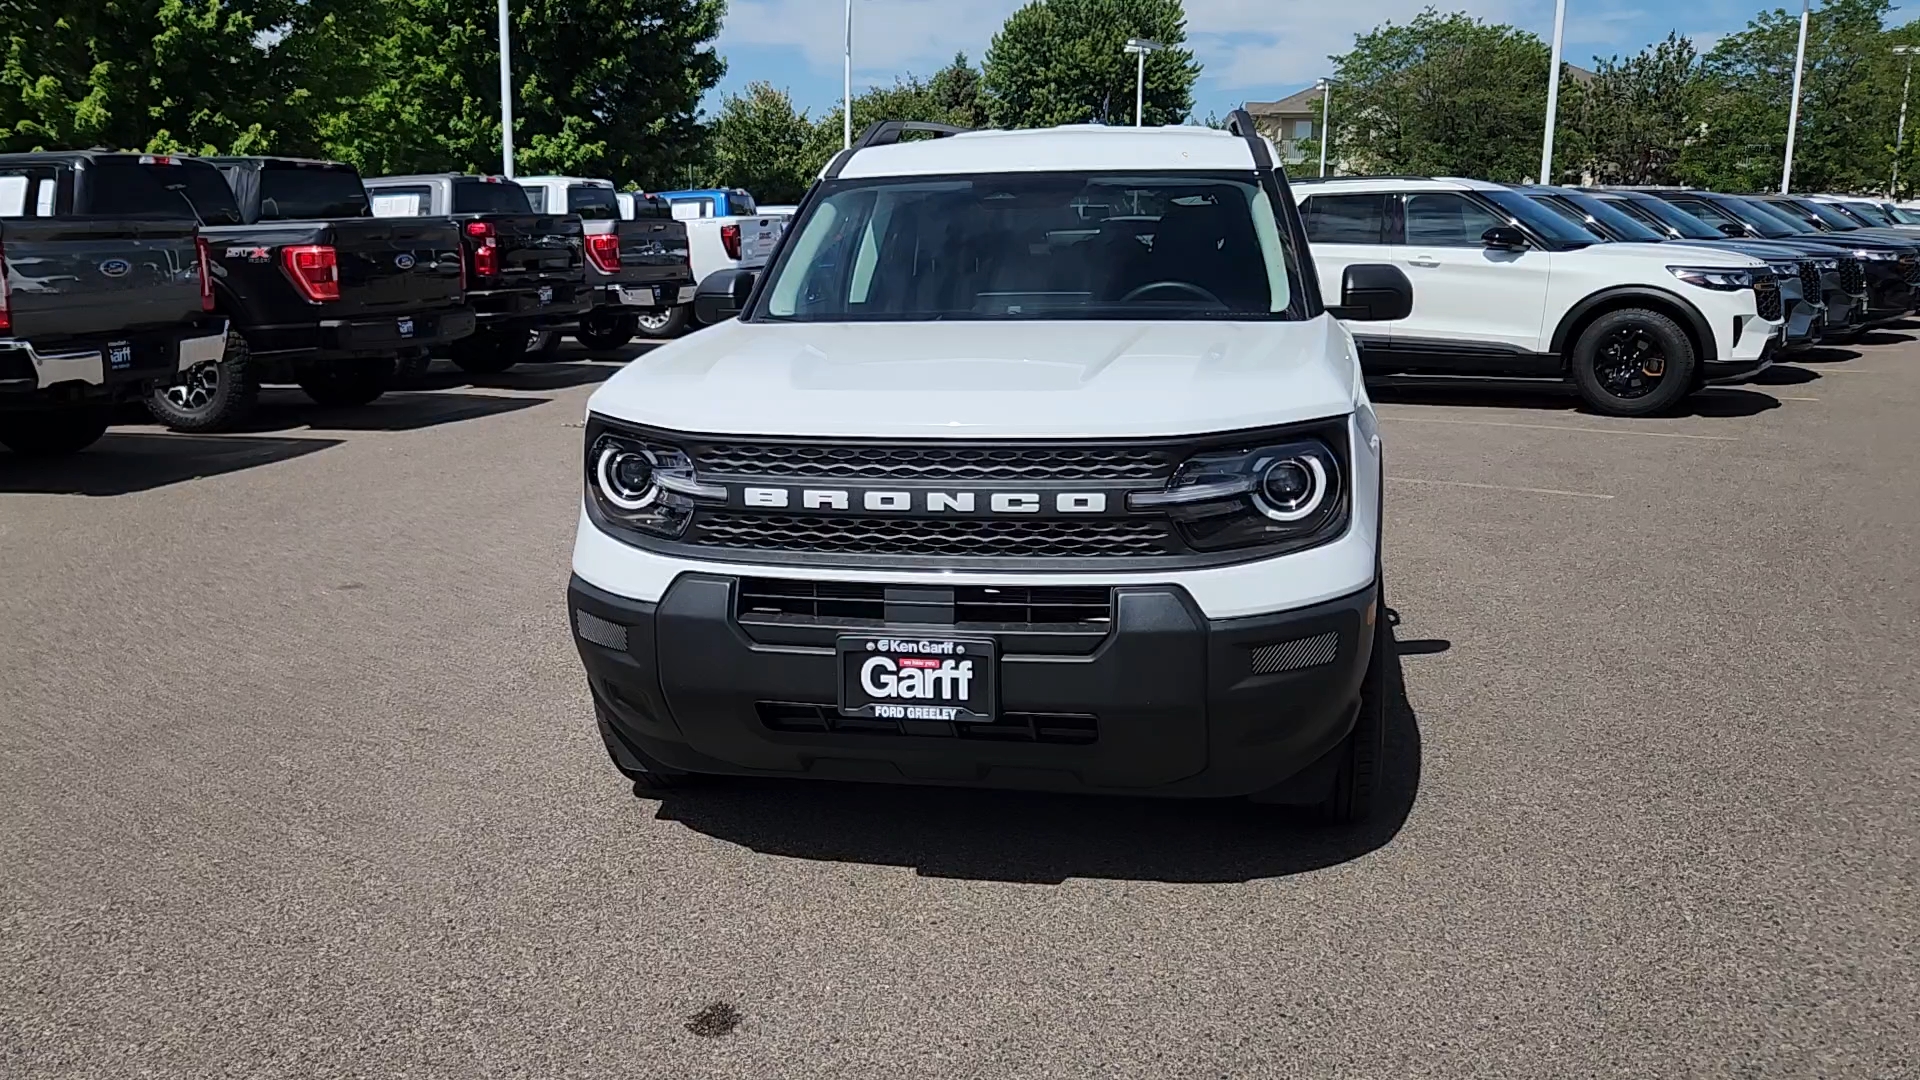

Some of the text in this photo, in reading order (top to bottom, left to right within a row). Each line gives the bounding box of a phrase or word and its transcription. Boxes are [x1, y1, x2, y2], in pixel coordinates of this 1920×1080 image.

[743, 487, 1107, 513] BRONCO
[890, 640, 917, 653] Ken
[918, 641, 954, 654] Garff
[860, 656, 973, 701] Garff
[875, 706, 957, 721] FORD GREELEY
